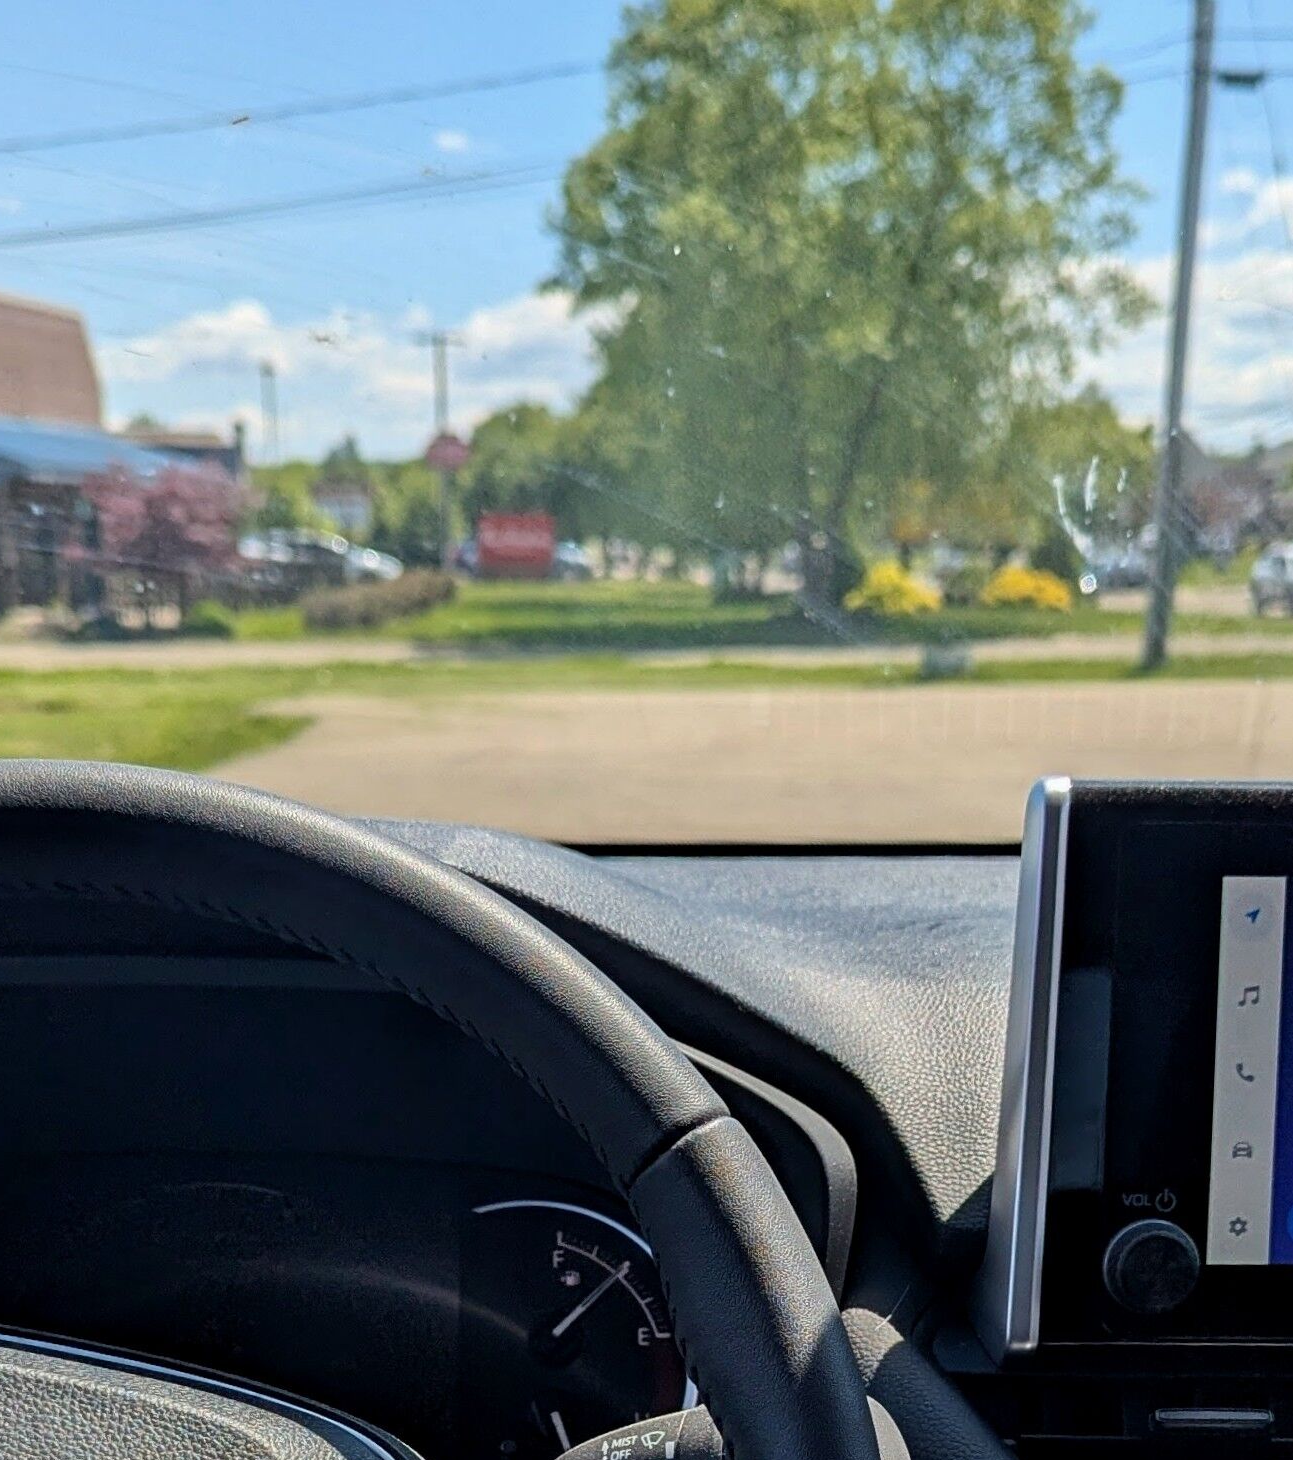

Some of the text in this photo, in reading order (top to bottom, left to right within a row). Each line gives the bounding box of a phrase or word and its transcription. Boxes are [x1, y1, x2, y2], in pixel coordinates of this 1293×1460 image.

[1122, 1193, 1152, 1206] VOL
[553, 1250, 564, 1268] F
[638, 1327, 650, 1346] E
[611, 1435, 638, 1448] MIST
